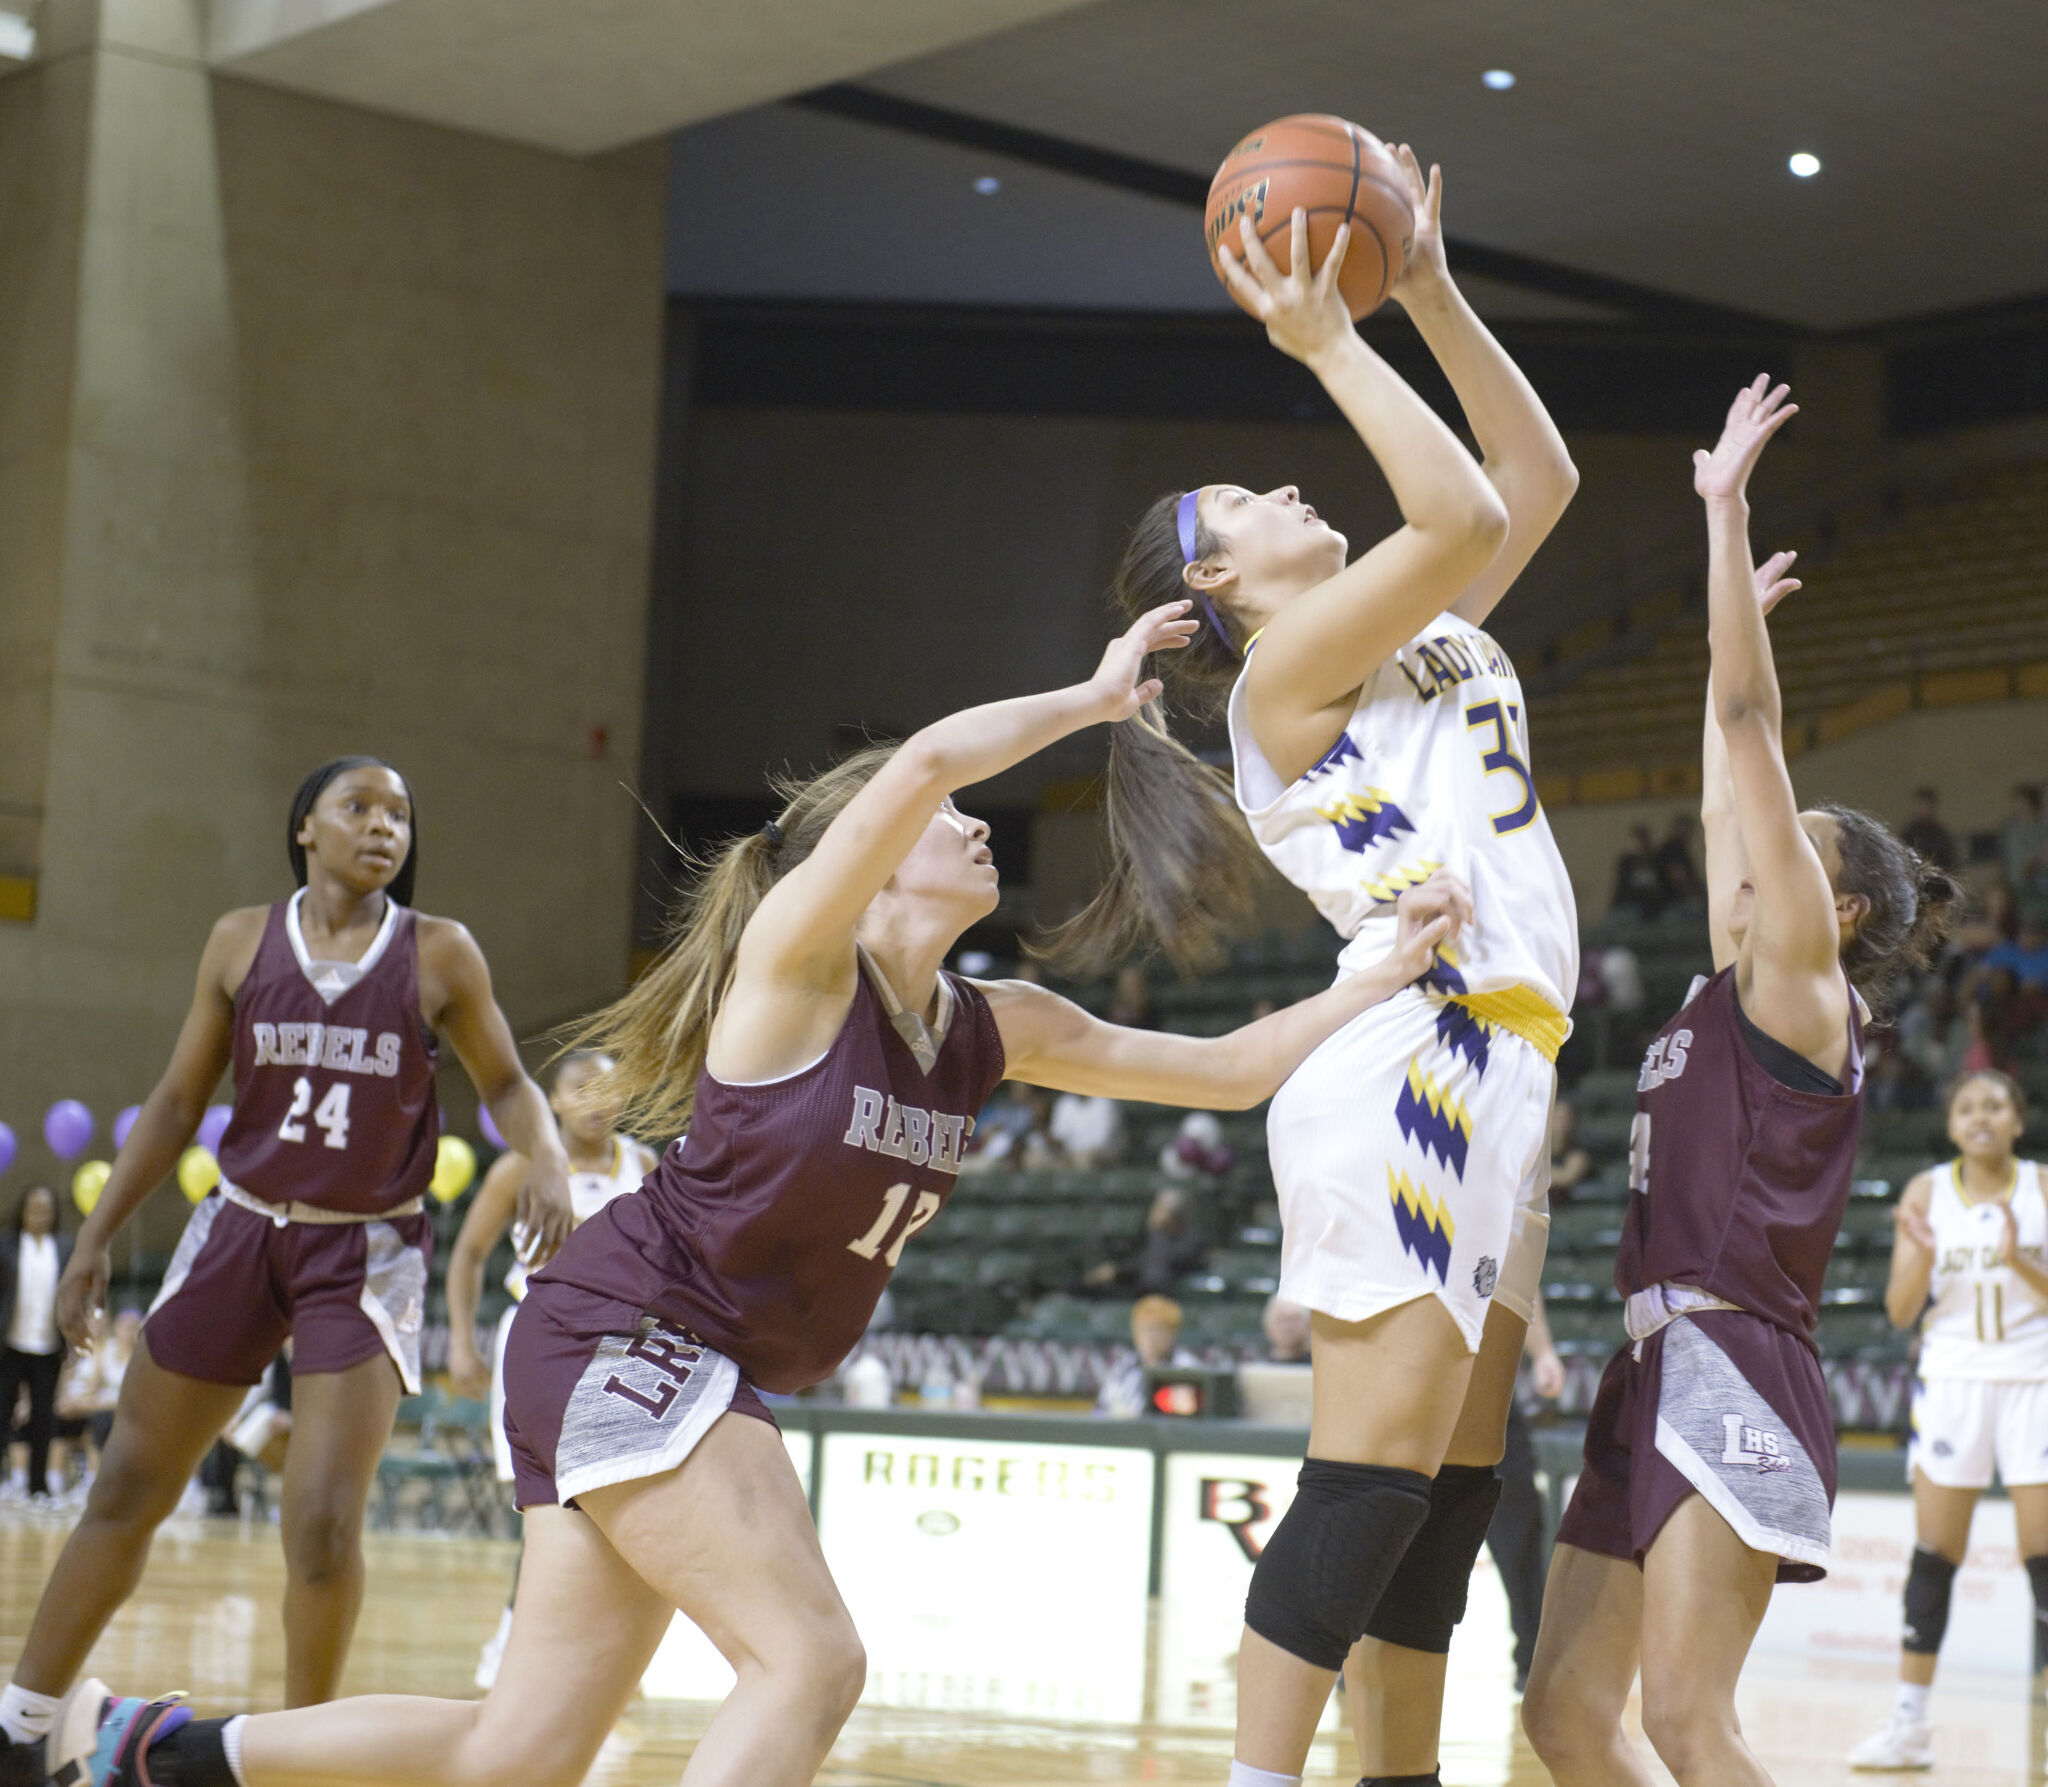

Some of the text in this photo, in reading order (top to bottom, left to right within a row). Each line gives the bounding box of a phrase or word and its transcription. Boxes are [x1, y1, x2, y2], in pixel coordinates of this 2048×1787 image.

[277, 1076, 352, 1150] 24
[1973, 1281, 2006, 1343] 11
[862, 1450, 1118, 1502] ROGERS
